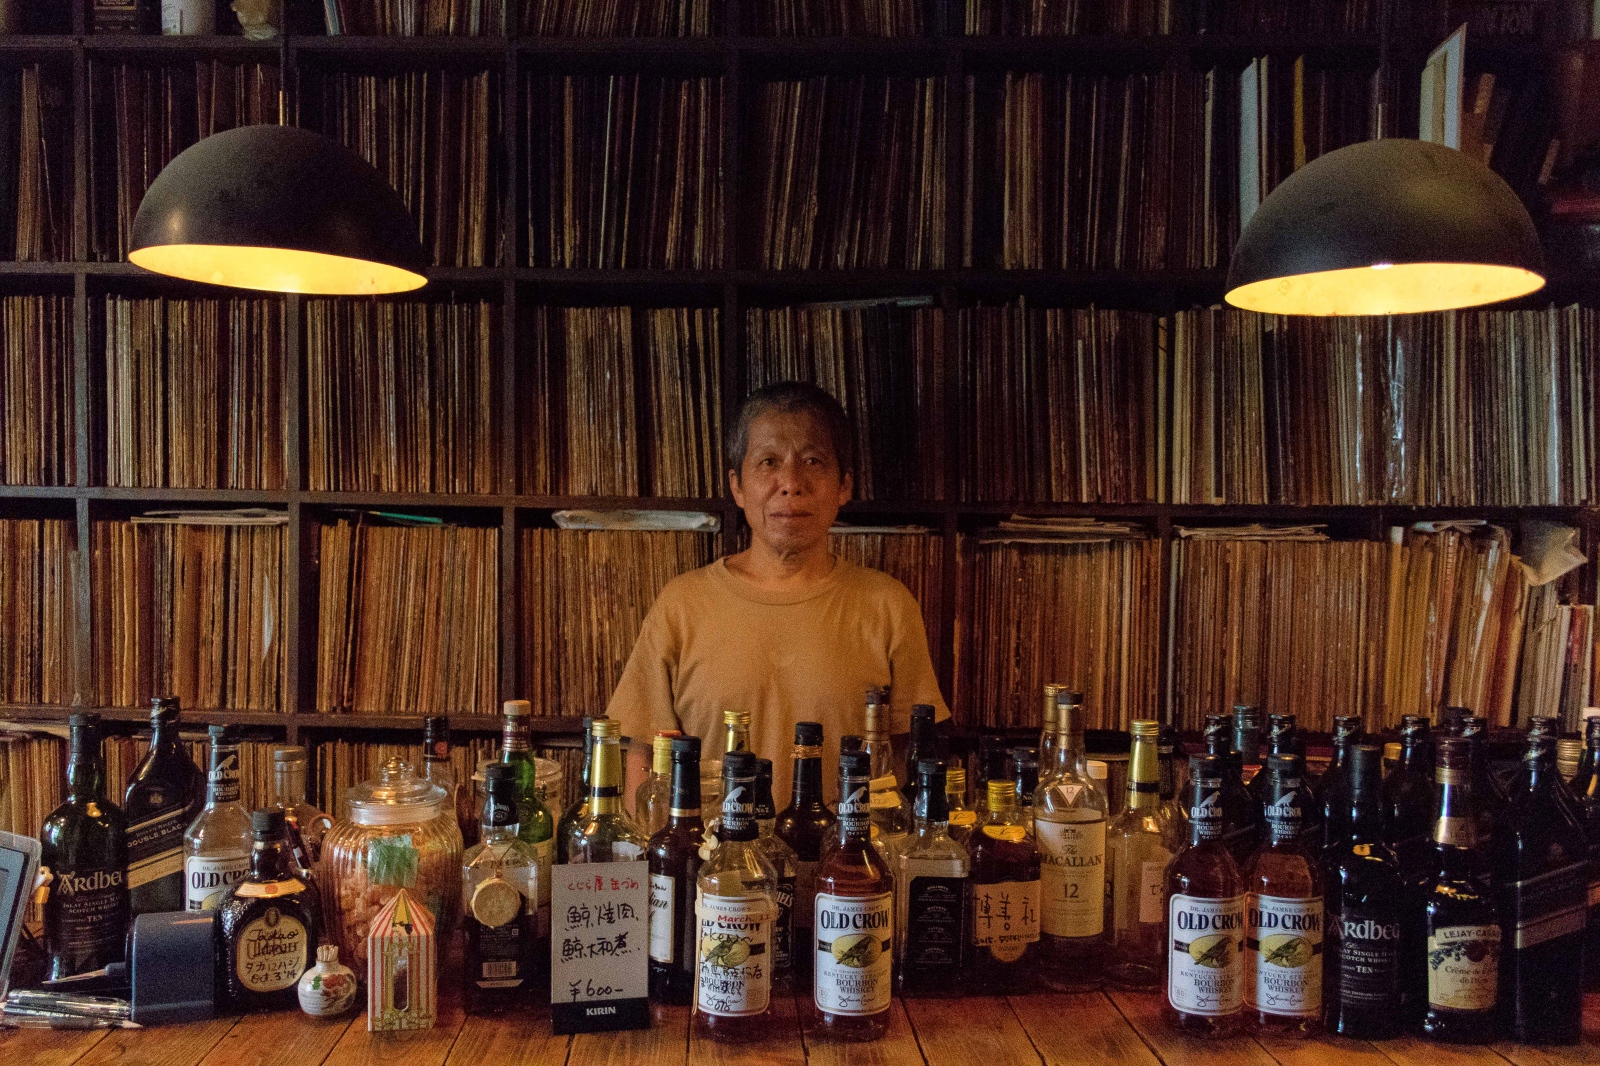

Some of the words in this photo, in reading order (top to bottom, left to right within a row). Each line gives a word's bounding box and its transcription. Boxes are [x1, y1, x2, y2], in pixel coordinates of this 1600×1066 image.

[1190, 806, 1208, 818] OLD
[1267, 805, 1282, 818] OLD
[127, 831, 159, 848] DOUBLE
[1040, 853, 1104, 867] MACALLAN
[191, 871, 220, 889] OLD
[1063, 883, 1079, 898] 12
[820, 910, 850, 930] OLD
[852, 909, 889, 930] CROW
[1177, 910, 1209, 930] OLD
[1211, 913, 1244, 930] CROW
[1249, 908, 1279, 928] OLD
[1281, 913, 1320, 932] CROW
[1355, 965, 1374, 974] TEN
[836, 978, 879, 987] BOURBON
[1194, 978, 1235, 987] BOURBON
[1263, 976, 1308, 987] BOURBON
[840, 985, 875, 995] WHISKEY
[1198, 985, 1233, 995] WHISKEY
[1267, 984, 1305, 995] WHISKEY
[585, 1006, 617, 1017] KIRIN
